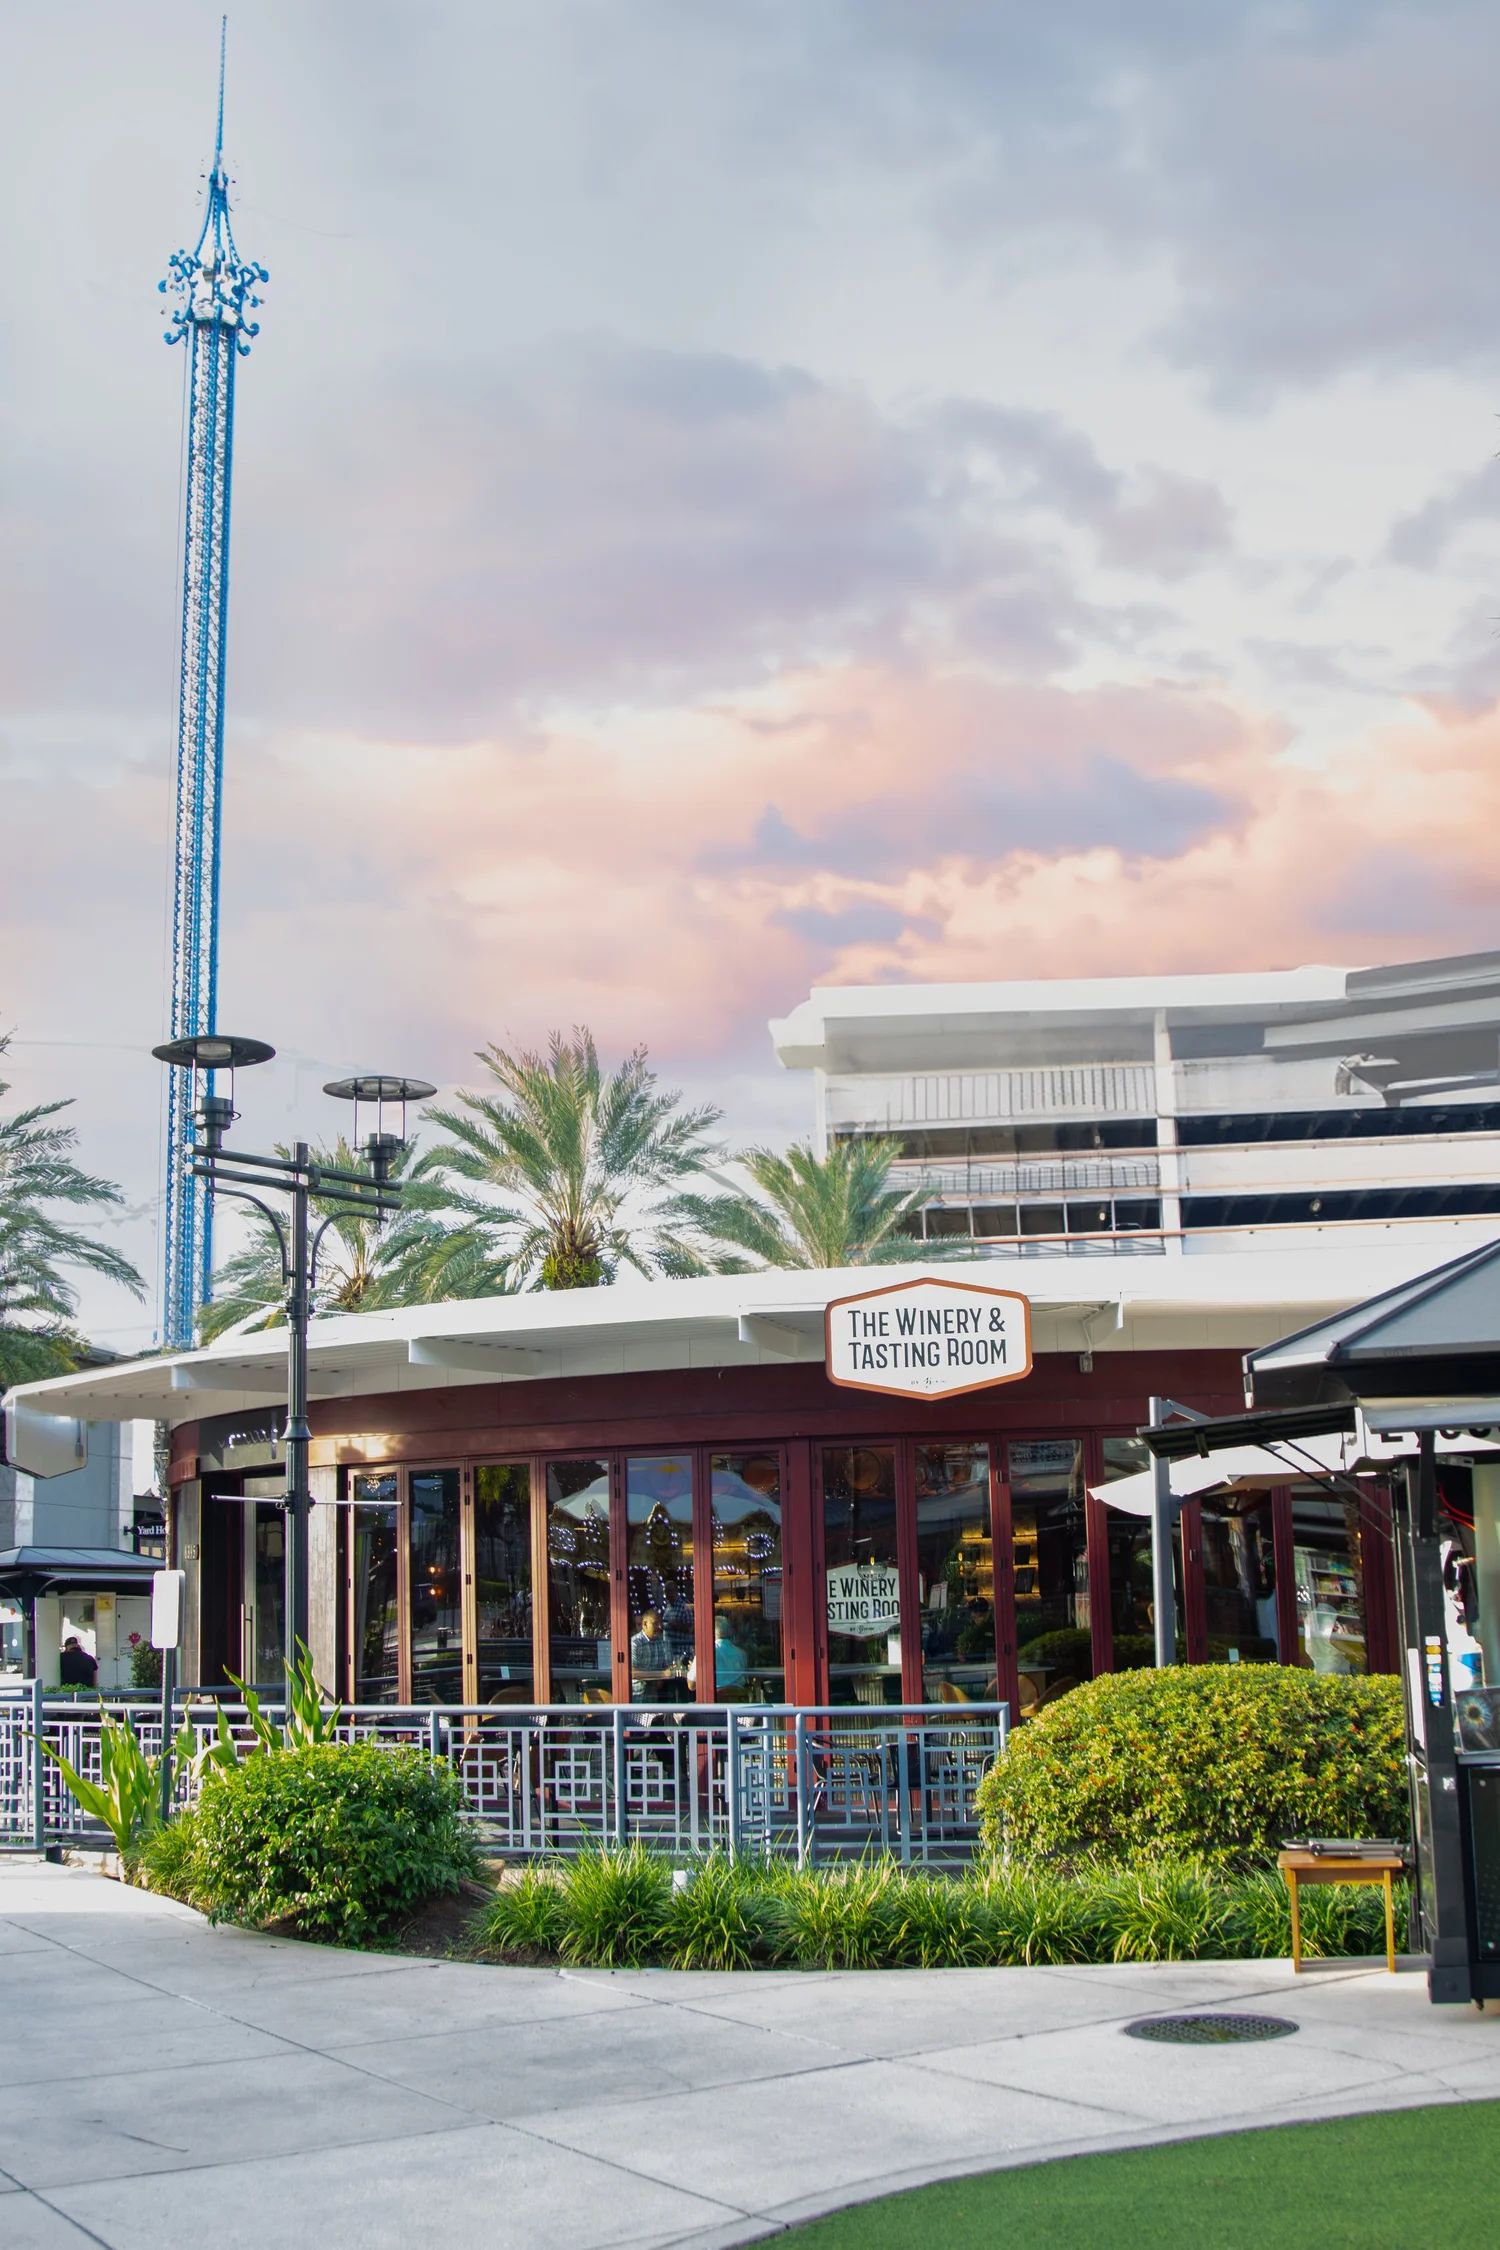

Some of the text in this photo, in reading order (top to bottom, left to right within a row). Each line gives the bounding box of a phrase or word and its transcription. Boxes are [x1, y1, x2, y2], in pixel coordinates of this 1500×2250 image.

[847, 1306, 1006, 1338] THE WINERY &
[848, 1337, 1007, 1370] TASTING ROOM
[137, 1525, 154, 1535] Yard
[840, 1577, 897, 1598] WINERY
